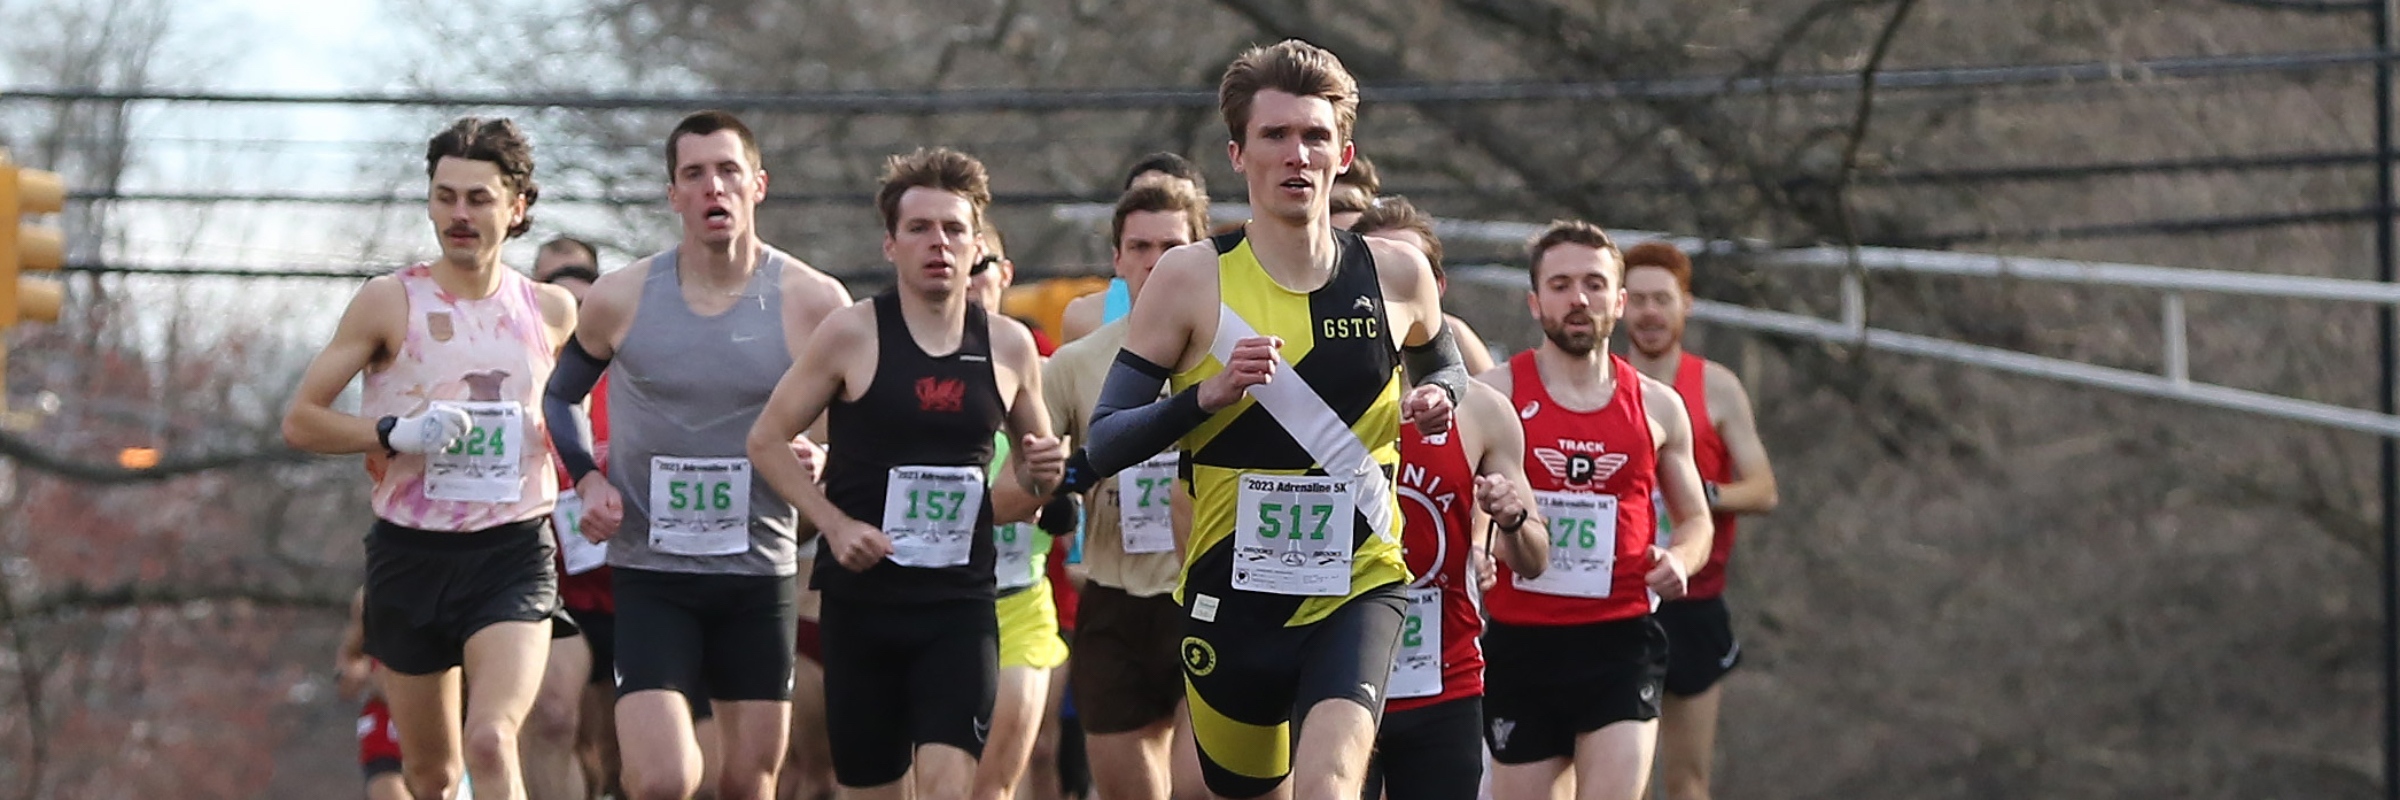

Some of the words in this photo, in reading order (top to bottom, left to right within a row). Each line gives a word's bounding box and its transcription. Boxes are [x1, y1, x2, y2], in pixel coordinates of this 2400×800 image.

[1323, 317, 1377, 338] GSTC
[1558, 438, 1605, 452] TRACK
[1572, 456, 1590, 479] P
[669, 481, 732, 510] 516
[1248, 479, 1274, 492] 2023
[1276, 480, 1331, 493] Adrenaline
[1334, 482, 1347, 493] 5K
[906, 490, 966, 521] 157
[1259, 503, 1334, 540] 517
[1548, 516, 1597, 549] 76
